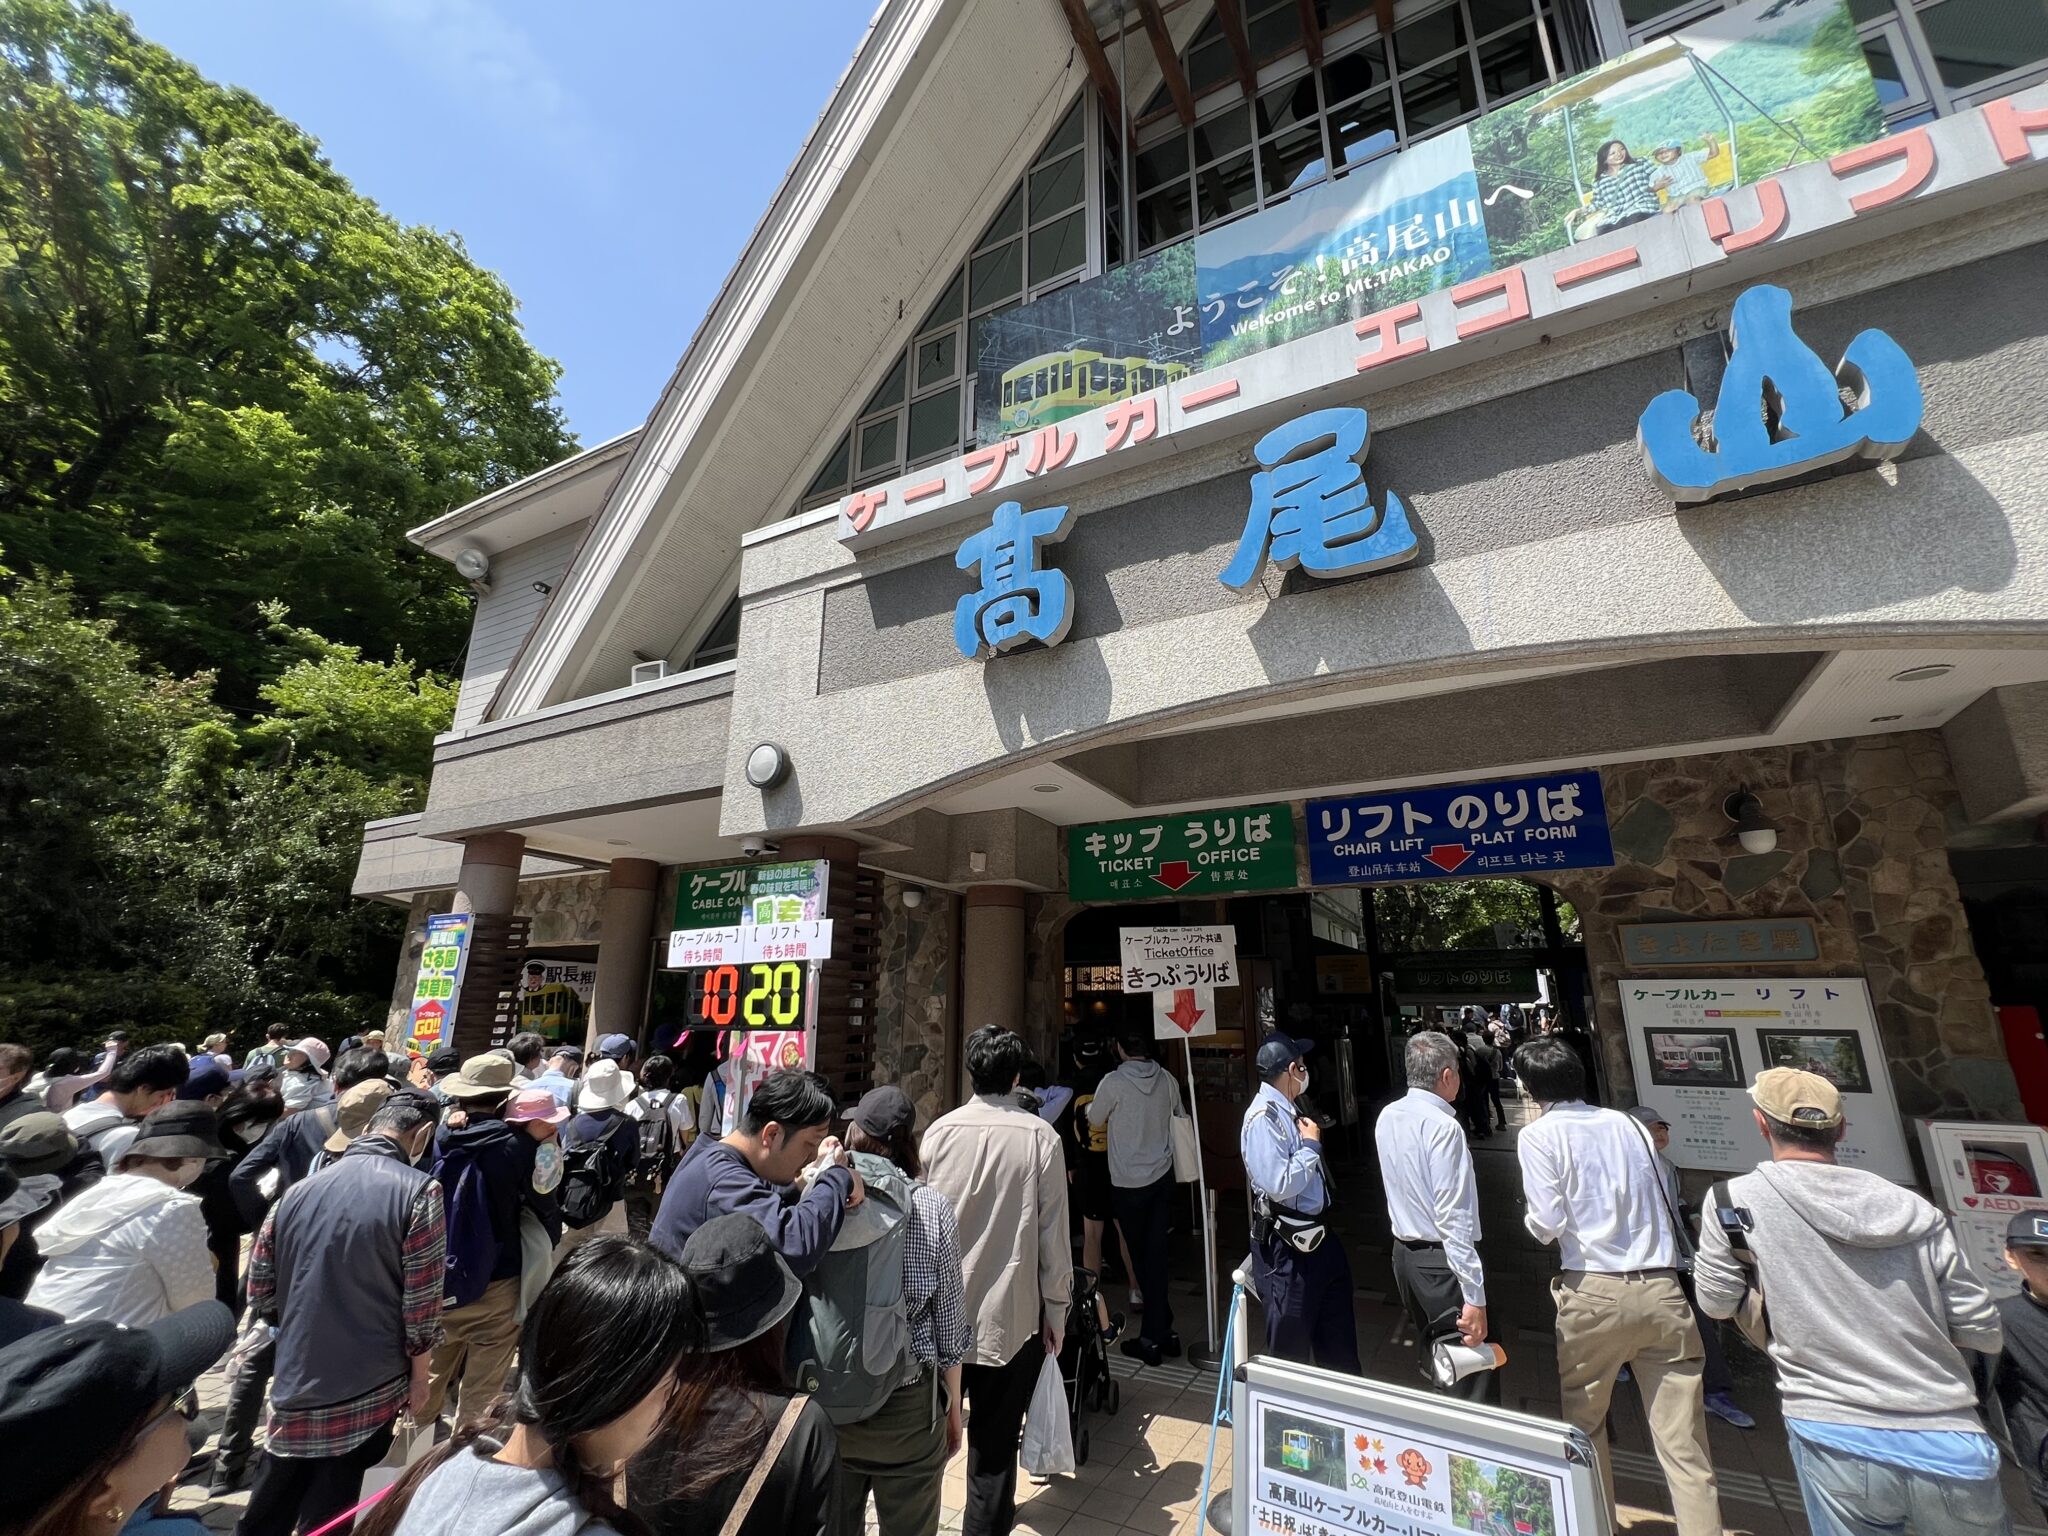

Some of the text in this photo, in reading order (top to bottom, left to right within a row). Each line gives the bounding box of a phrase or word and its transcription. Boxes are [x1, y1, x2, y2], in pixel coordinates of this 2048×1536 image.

[1230, 247, 1451, 337] Welcome to Mt.TAKAO
[847, 379, 1239, 532] ケーブルカー
[1322, 782, 1584, 842] リフト のりば
[1184, 813, 1272, 848] うりば
[1333, 825, 1577, 857] CHAIR LIFT PLAT FORM
[1099, 848, 1260, 873] TICKET OFFICE
[692, 898, 723, 910] CABLE
[684, 948, 723, 964] 待ち時間
[762, 942, 807, 959] 待ち時間
[1144, 945, 1214, 959] TicketOffice
[546, 965, 596, 984] 駅長推
[702, 964, 739, 1025] 10
[744, 962, 801, 1025] 20
[1633, 987, 1839, 1001] ケーブルカー リフト
[414, 1017, 442, 1037] GO!!
[1983, 1197, 2021, 1211] AED
